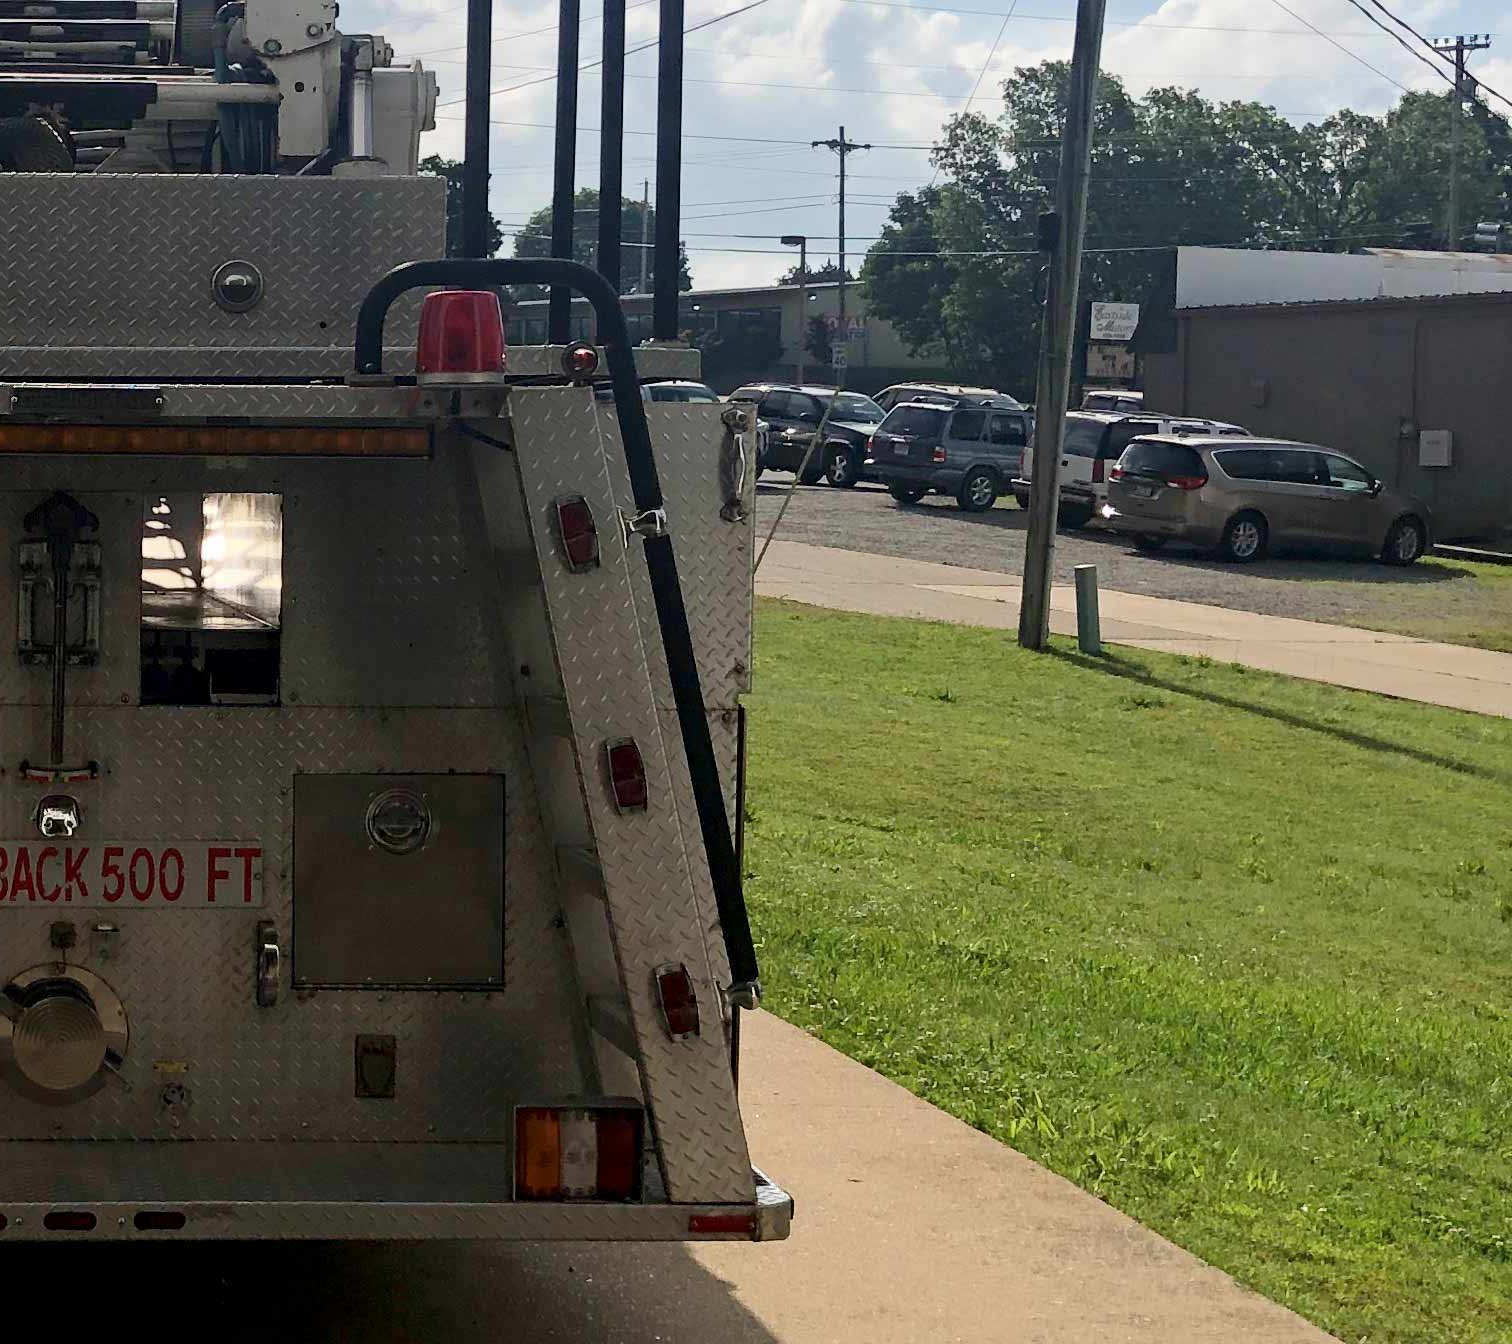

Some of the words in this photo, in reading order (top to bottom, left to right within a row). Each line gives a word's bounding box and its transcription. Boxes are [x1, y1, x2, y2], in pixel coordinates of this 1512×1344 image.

[834, 355, 846, 366] 40
[101, 846, 185, 902] 500
[207, 847, 262, 903] FT
